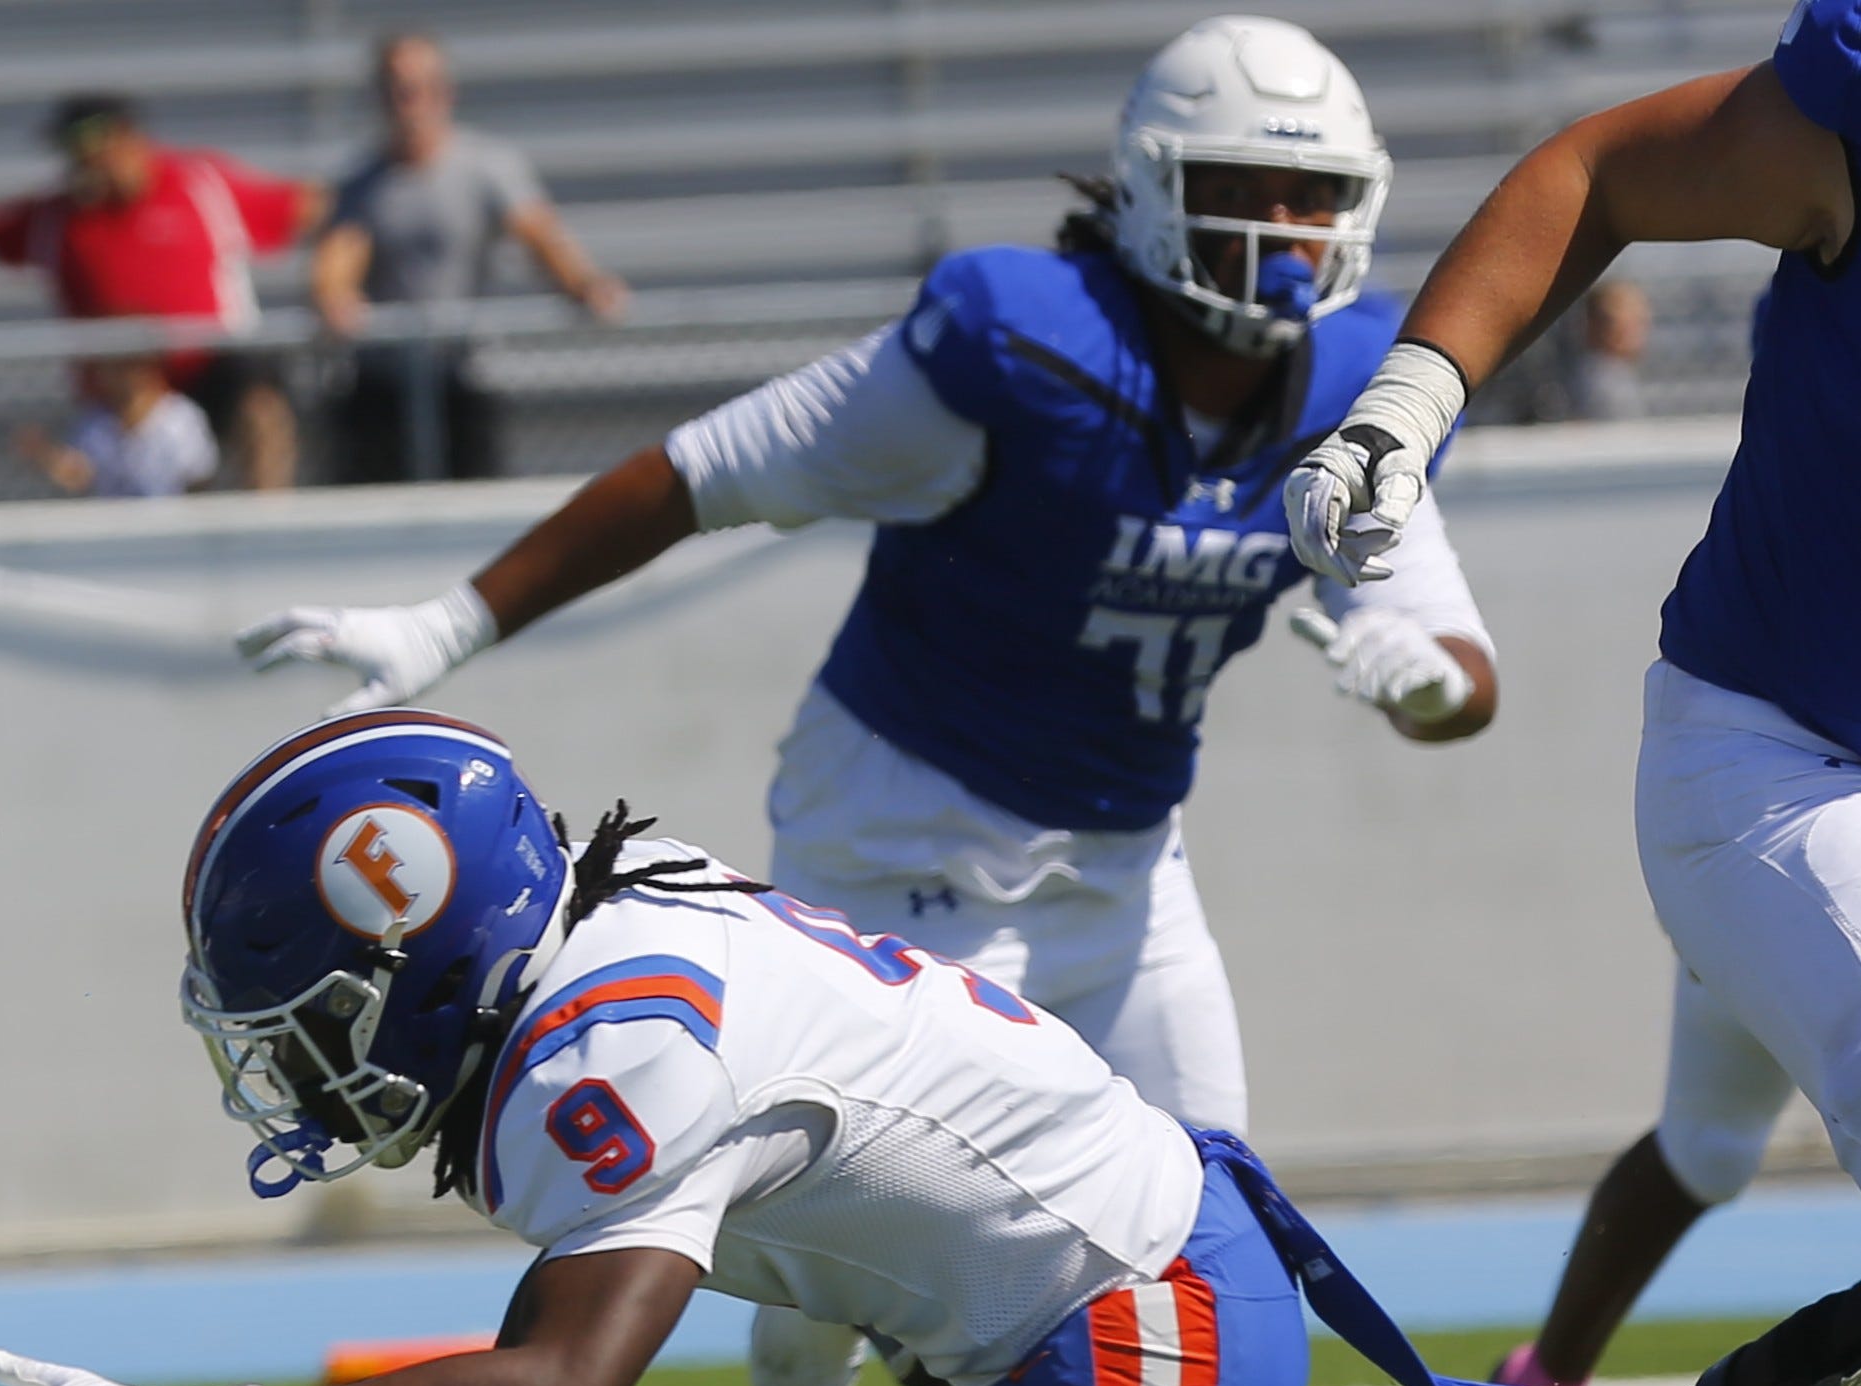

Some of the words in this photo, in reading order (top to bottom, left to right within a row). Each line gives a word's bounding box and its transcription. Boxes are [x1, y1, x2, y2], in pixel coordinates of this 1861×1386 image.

[1103, 514, 1290, 590] IMG
[332, 814, 420, 920] F
[545, 1078, 657, 1195] 9
